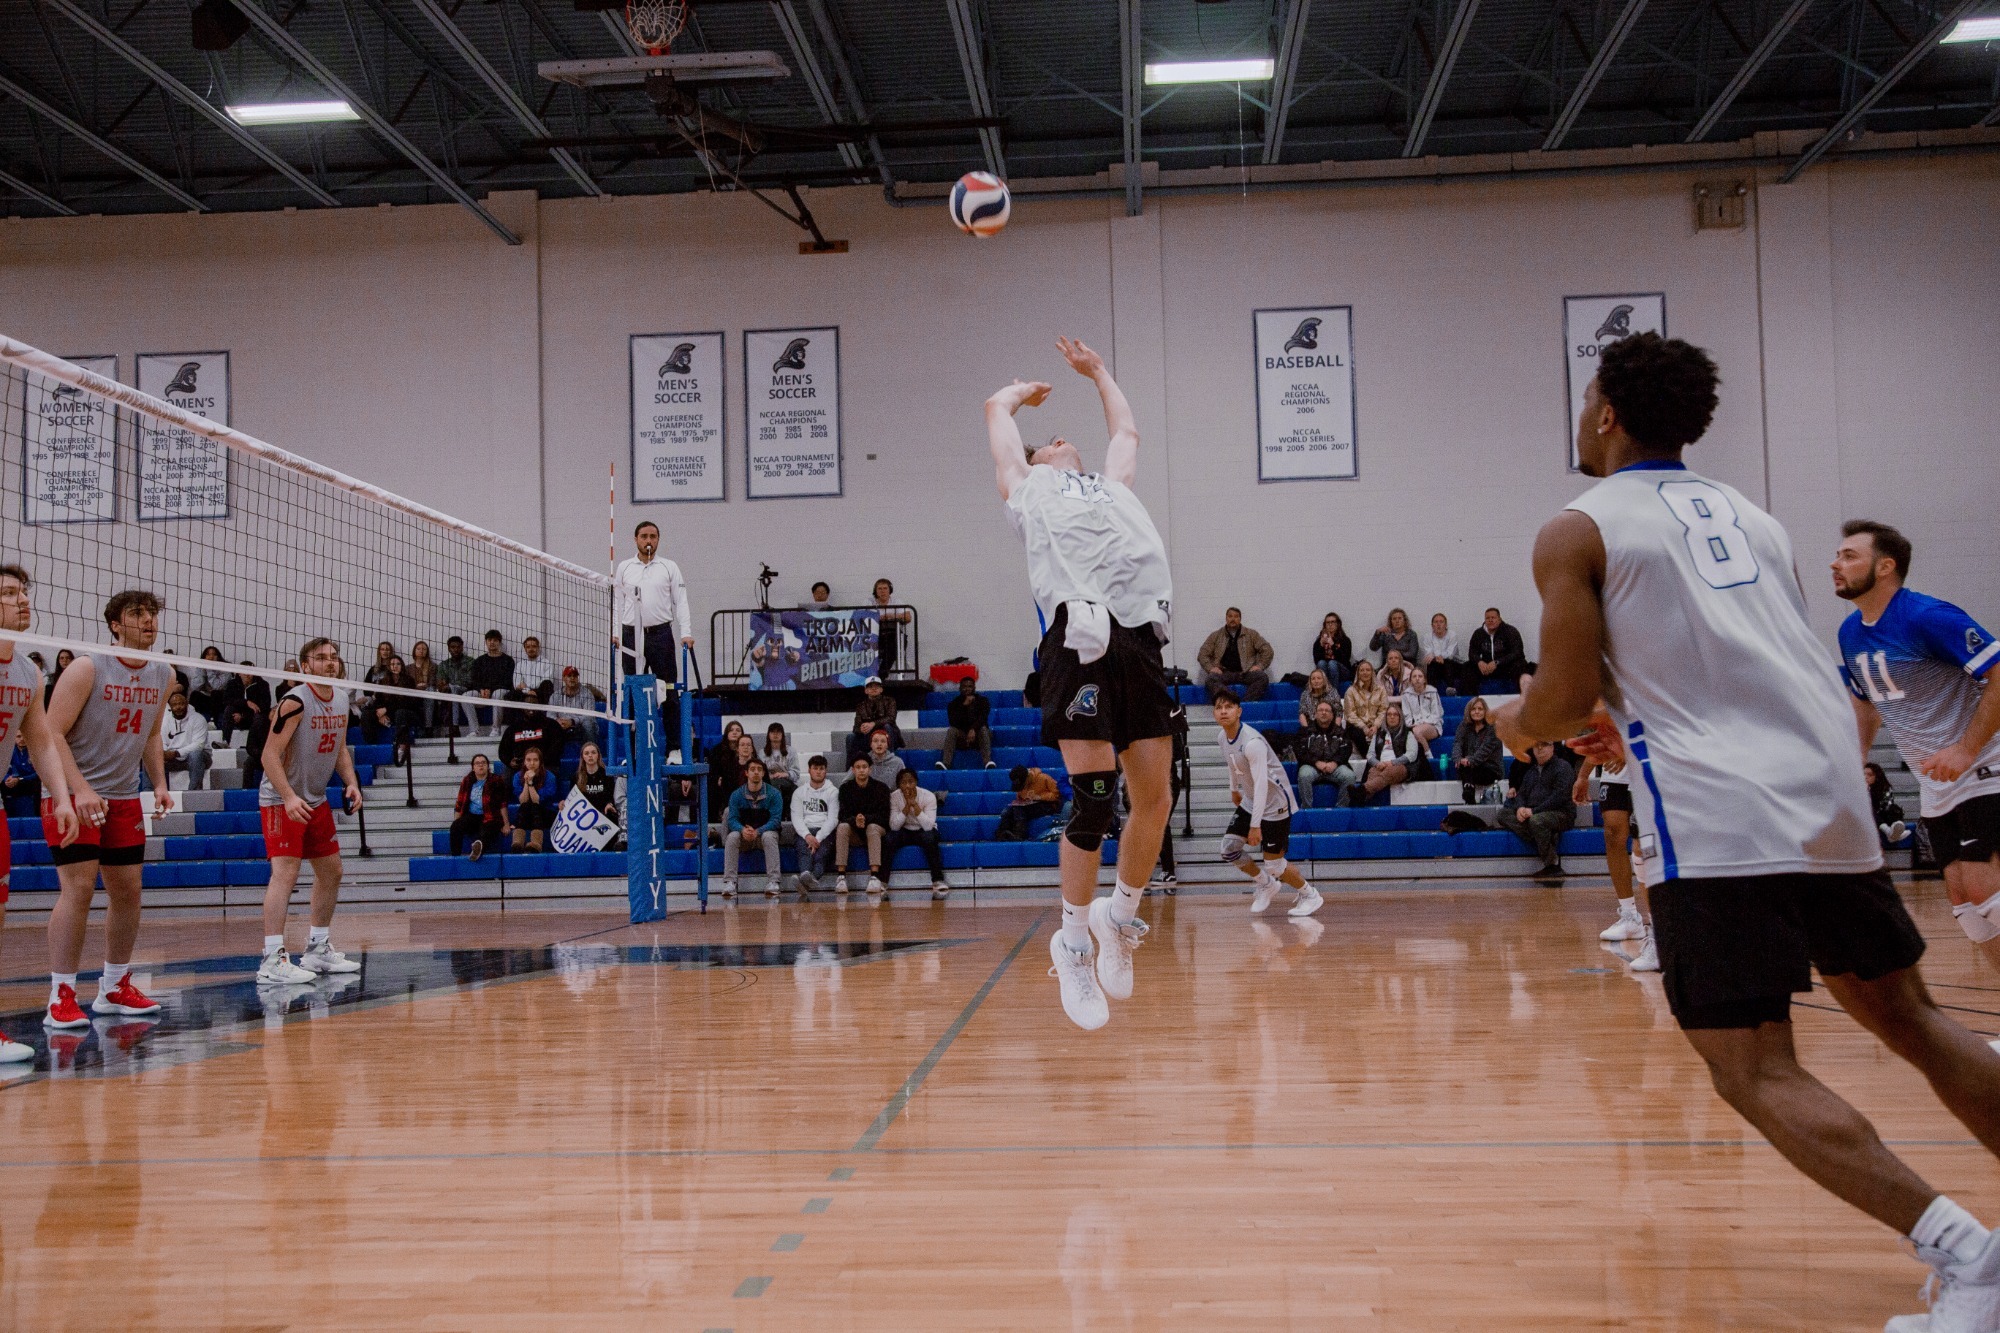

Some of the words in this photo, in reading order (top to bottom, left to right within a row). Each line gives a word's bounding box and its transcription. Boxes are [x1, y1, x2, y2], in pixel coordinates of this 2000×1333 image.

[1265, 355, 1344, 370] BASEBALL
[658, 378, 698, 390] MEN'S
[772, 374, 812, 386] MEN'S
[654, 392, 702, 404] SOCCER
[769, 388, 816, 400] SOCCER
[1284, 390, 1326, 398] REGIONAL
[1280, 398, 1330, 406] CHAMPIONS
[40, 402, 102, 413] WOMEN'S
[1296, 406, 1315, 414] 2006
[652, 414, 704, 423] CONFERENCE
[759, 410, 786, 418] NCCAA
[788, 410, 826, 418] REGIONAL
[48, 416, 94, 426] SOCCER
[654, 421, 702, 430] CHAMPIONS
[770, 416, 818, 425] CHAMPIONS
[640, 430, 656, 438] 1972
[660, 430, 676, 438] 1974
[760, 426, 776, 434] 1974
[810, 424, 827, 432] 1990
[1292, 428, 1320, 436] NCCAA
[785, 432, 802, 440] 2004
[1278, 436, 1308, 444] WORLD
[1286, 444, 1305, 452] 2005
[654, 456, 704, 464] CONFERENCE
[754, 455, 780, 464] NCCAA
[781, 454, 834, 462] TOURNAMENT
[652, 462, 706, 470] TOURNAMENT
[655, 470, 703, 478] CHAMPIONS
[764, 470, 781, 478] 2000
[1658, 480, 1760, 589] 8
[804, 618, 872, 636] TROJAN
[806, 636, 872, 654] ARMY'S
[801, 649, 876, 682] BATTLEFIELD
[1855, 651, 1905, 700] 11
[104, 684, 159, 705] STRITCH
[116, 708, 143, 734] 24
[318, 732, 338, 754] 25
[1230, 754, 1244, 776] 1
[643, 688, 666, 910] TRINITY
[567, 798, 599, 831] GO
